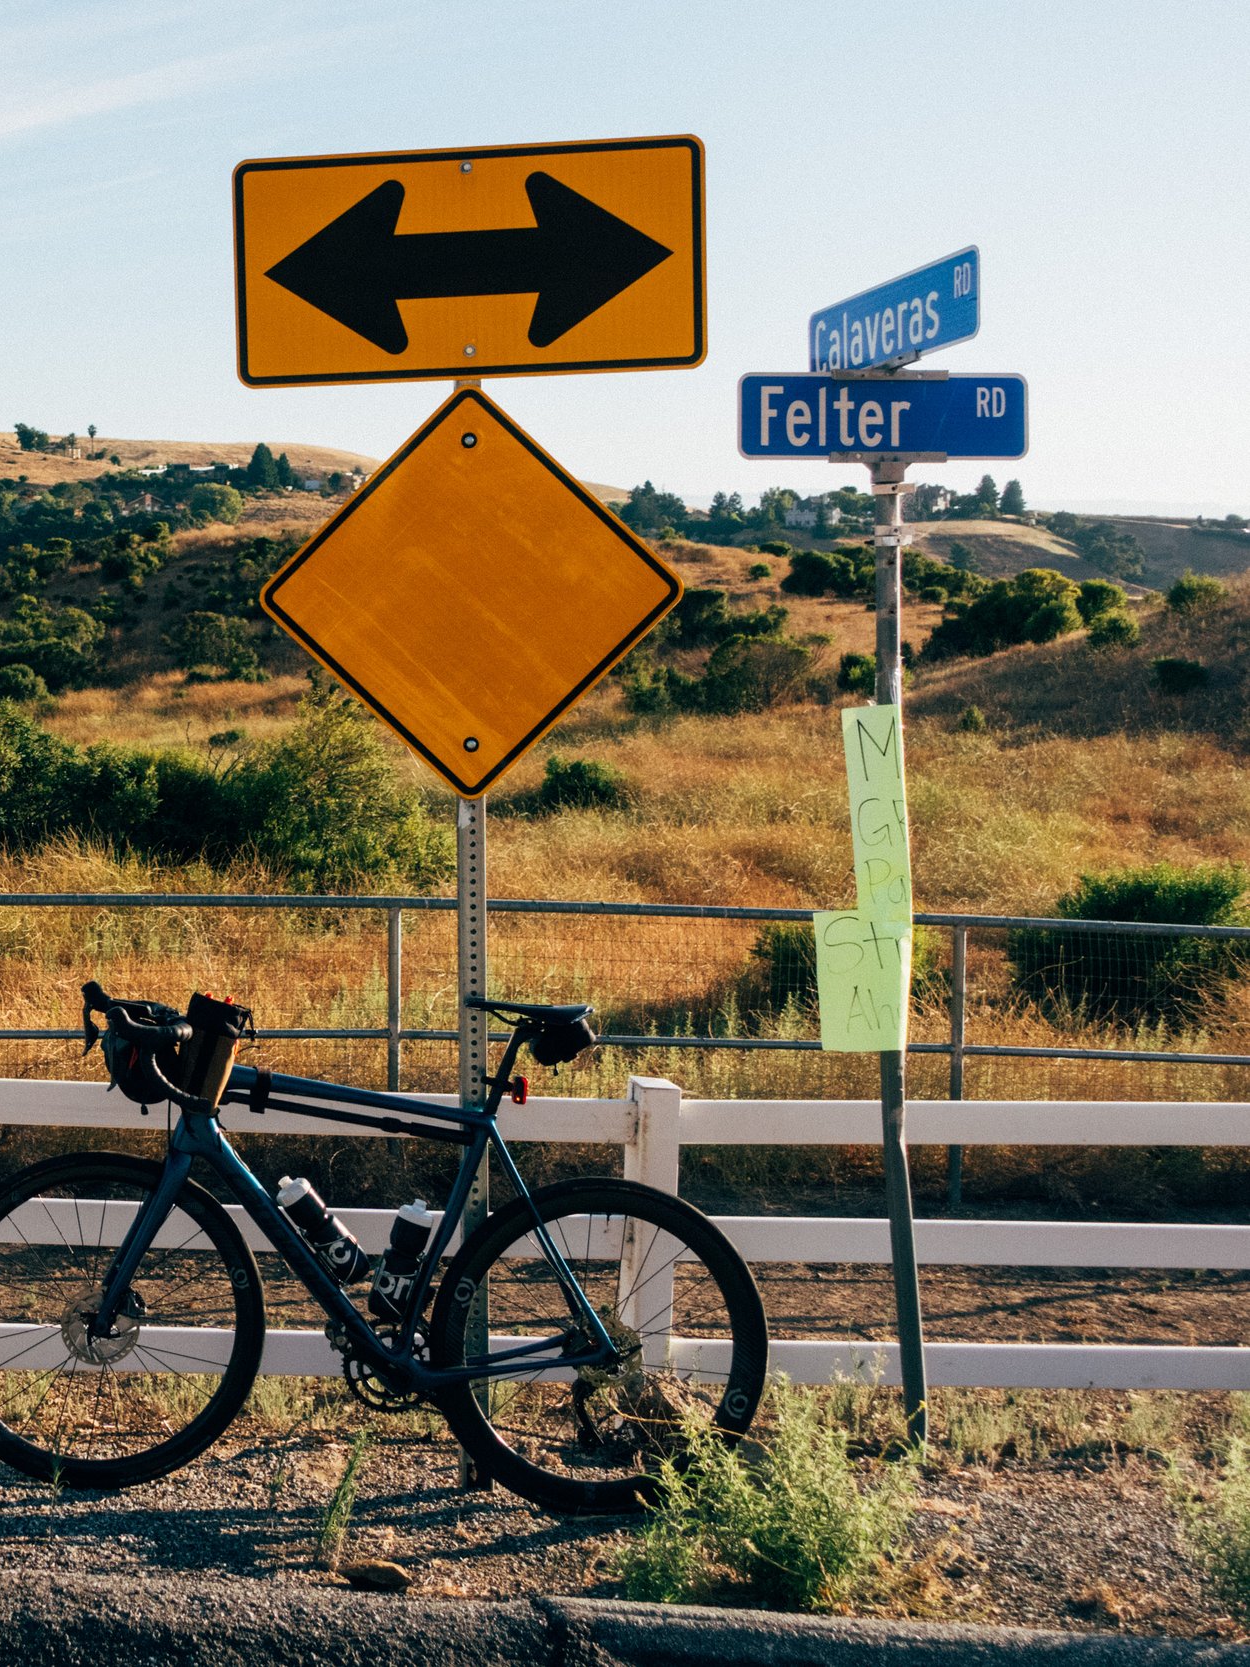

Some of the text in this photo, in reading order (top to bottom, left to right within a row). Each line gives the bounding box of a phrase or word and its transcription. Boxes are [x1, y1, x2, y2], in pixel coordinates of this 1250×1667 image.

[815, 262, 971, 371] Calaveras RD
[760, 386, 1006, 447] Felter RD
